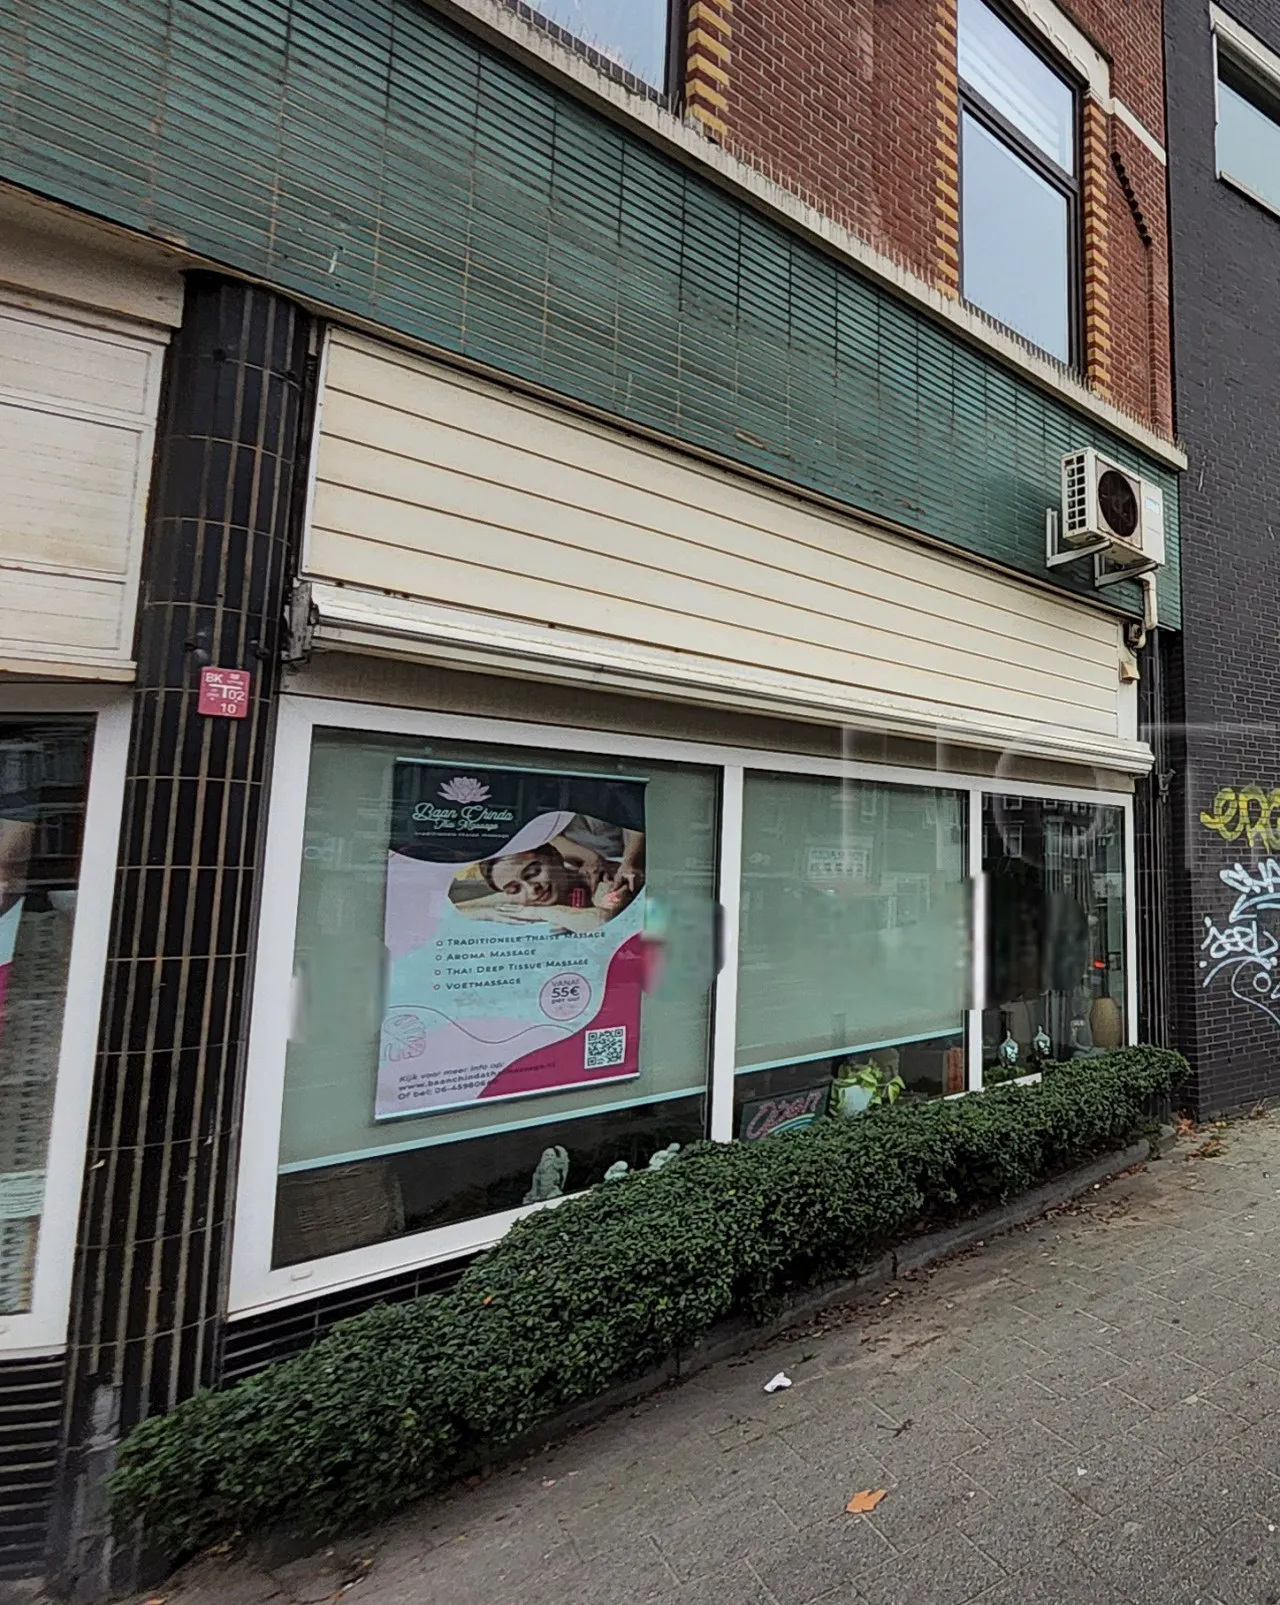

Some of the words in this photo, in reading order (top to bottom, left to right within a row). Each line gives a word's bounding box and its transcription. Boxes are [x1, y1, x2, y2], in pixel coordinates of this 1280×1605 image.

[205, 672, 224, 684] BK
[412, 802, 457, 821] Baan
[447, 953, 486, 961] AROMA
[490, 949, 536, 958] MASSAGE
[446, 967, 473, 975] THAI
[476, 965, 505, 974] DEEP
[508, 962, 542, 971] TISSUE
[546, 958, 589, 968] MASSAGE
[446, 978, 521, 990] VOETMASSAGE
[551, 986, 580, 998] 55€
